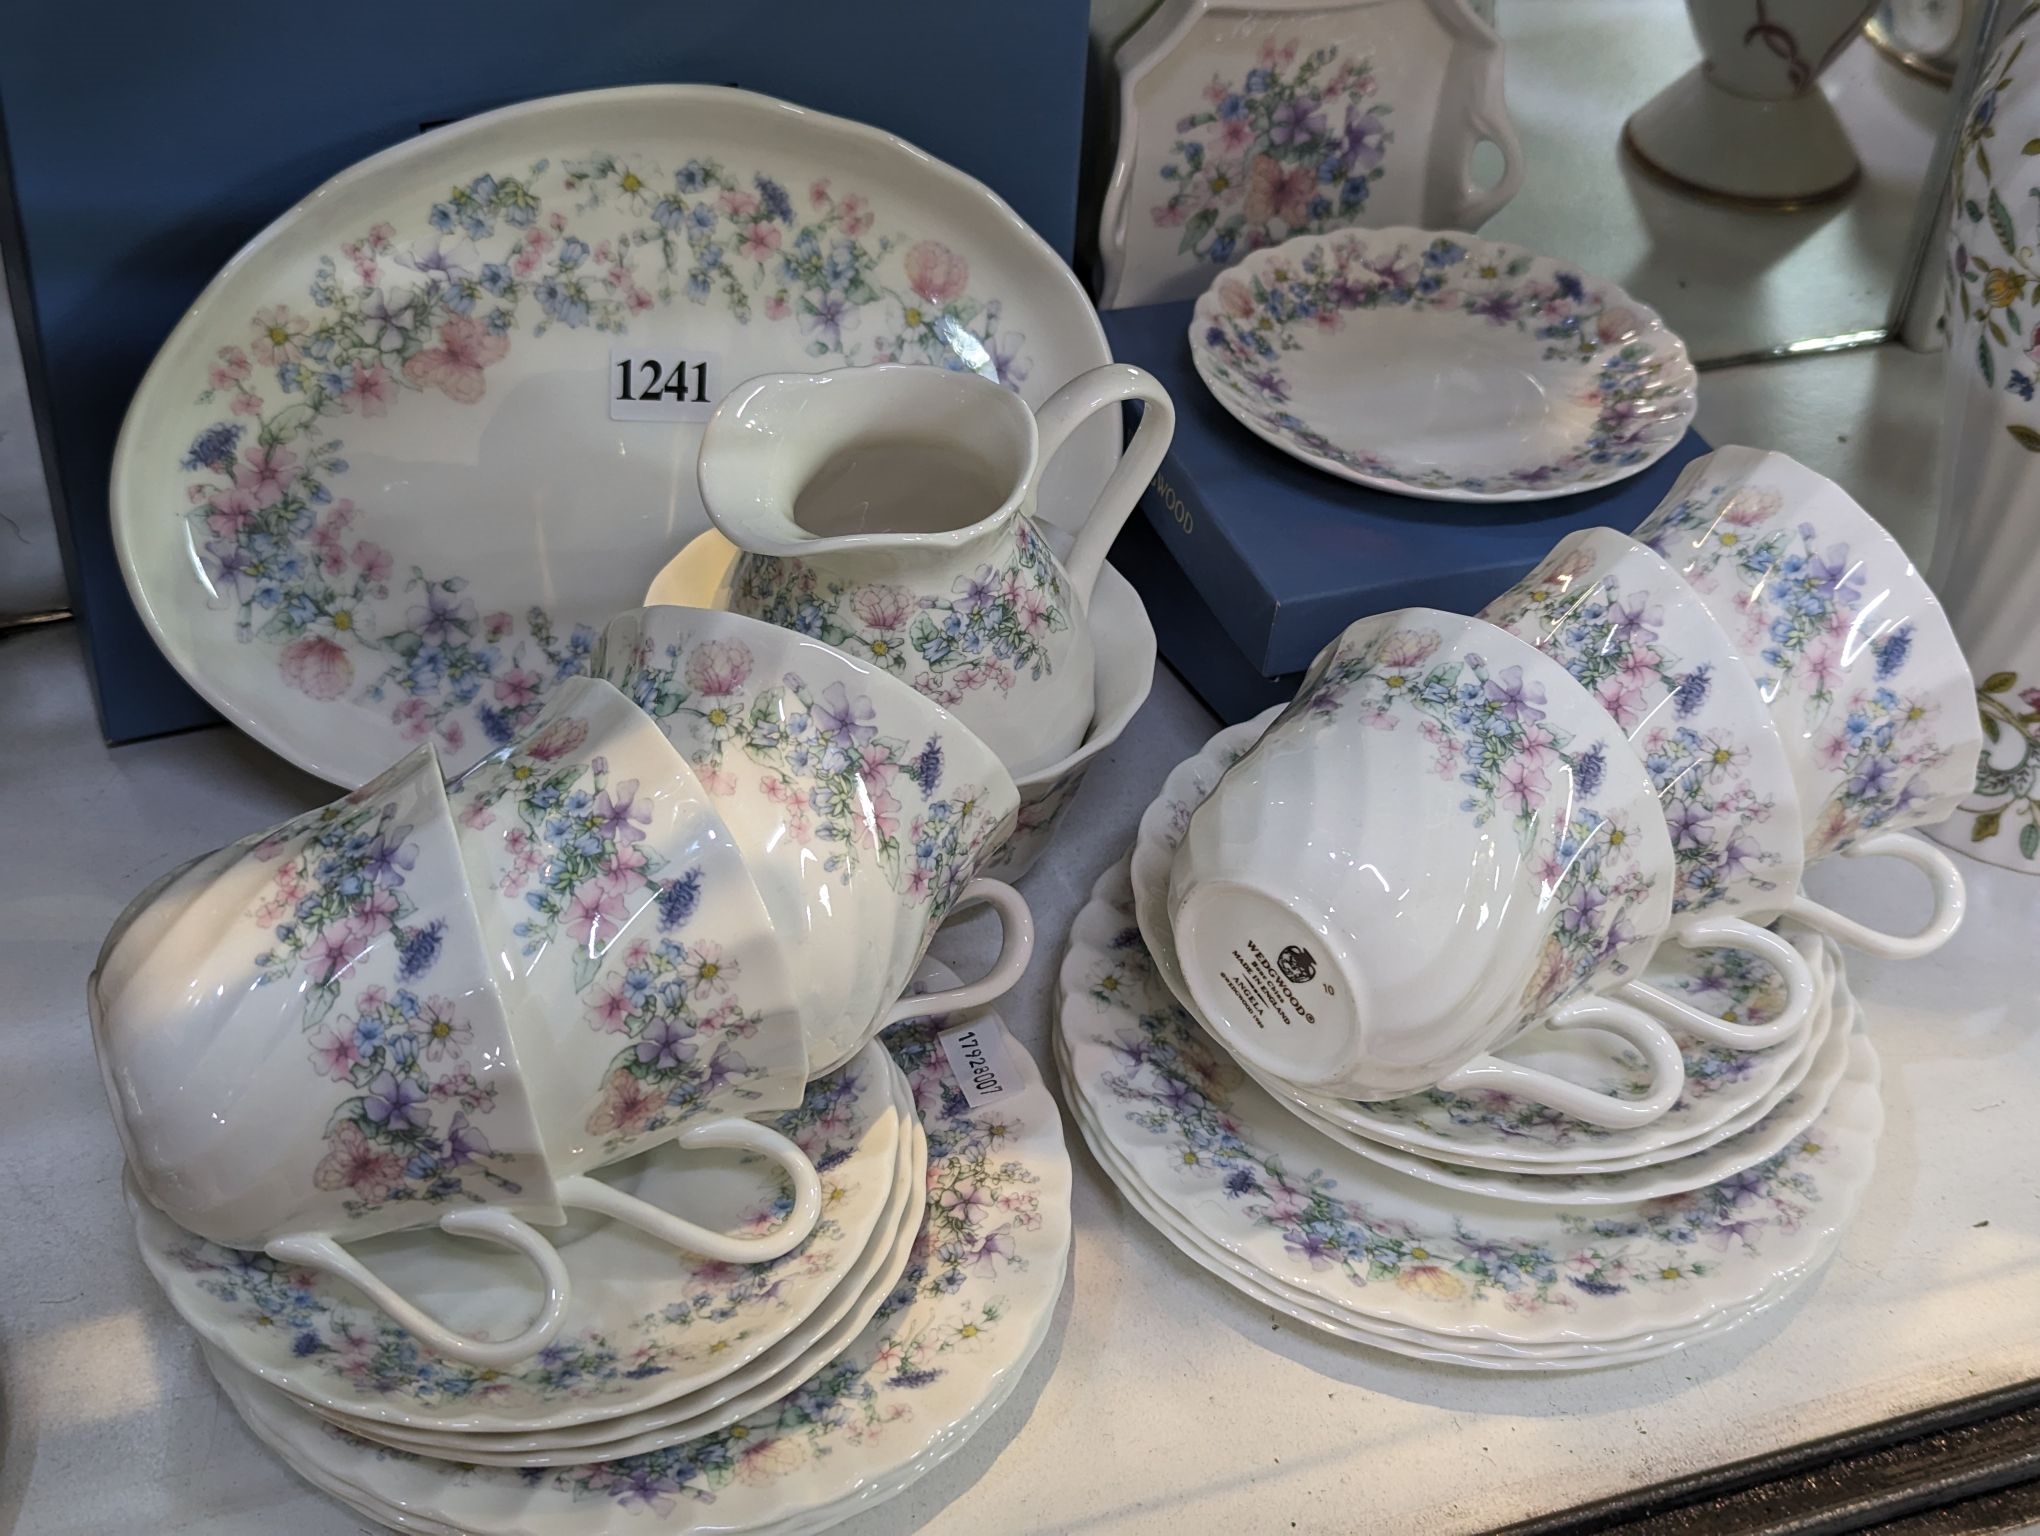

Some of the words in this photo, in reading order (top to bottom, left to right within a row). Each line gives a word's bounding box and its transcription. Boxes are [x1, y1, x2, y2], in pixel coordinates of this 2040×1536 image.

[616, 359, 711, 403] 1241
[1232, 950, 1252, 975] MADE
[1252, 974, 1262, 985] IN
[1260, 985, 1291, 1025] ENGLAND
[1232, 976, 1264, 1016] ANGELA
[958, 1031, 1003, 1095] 17928007
